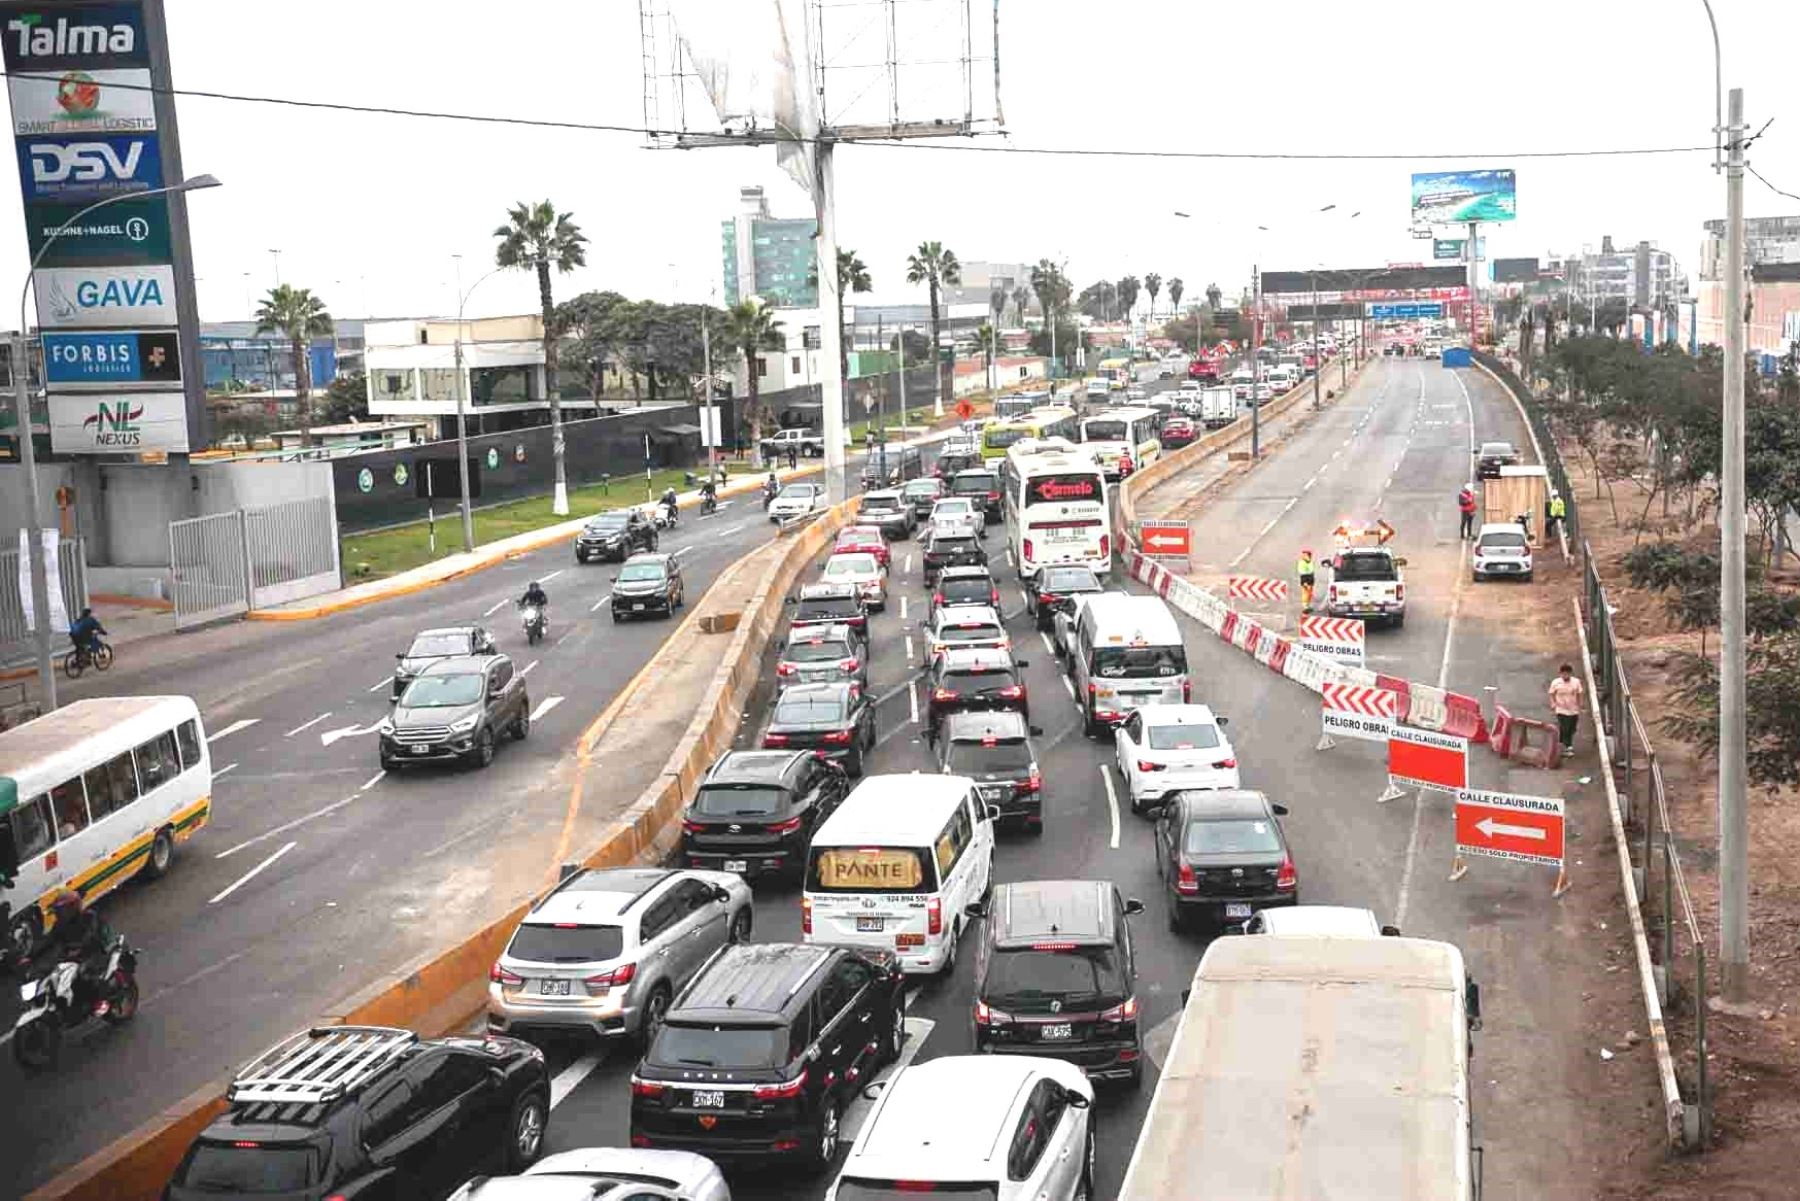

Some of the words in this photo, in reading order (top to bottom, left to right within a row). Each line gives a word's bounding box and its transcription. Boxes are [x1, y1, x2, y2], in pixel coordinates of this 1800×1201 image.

[8, 15, 135, 56] Talma
[30, 142, 144, 182] DSV
[77, 279, 163, 307] GAVA
[52, 345, 130, 363] FORBIS
[96, 433, 141, 445] NEXUS
[1303, 644, 1334, 653] PELIGRO
[1336, 646, 1361, 656] OBRAS
[1325, 716, 1361, 730] PELIGRO
[1363, 722, 1389, 734] OBRA
[1391, 730, 1413, 741] CALLE
[1415, 734, 1462, 749] CLAUSURADA
[1460, 792, 1491, 801] CALLE
[1493, 797, 1559, 812] CLAUSURADA
[835, 860, 902, 878] PANTE
